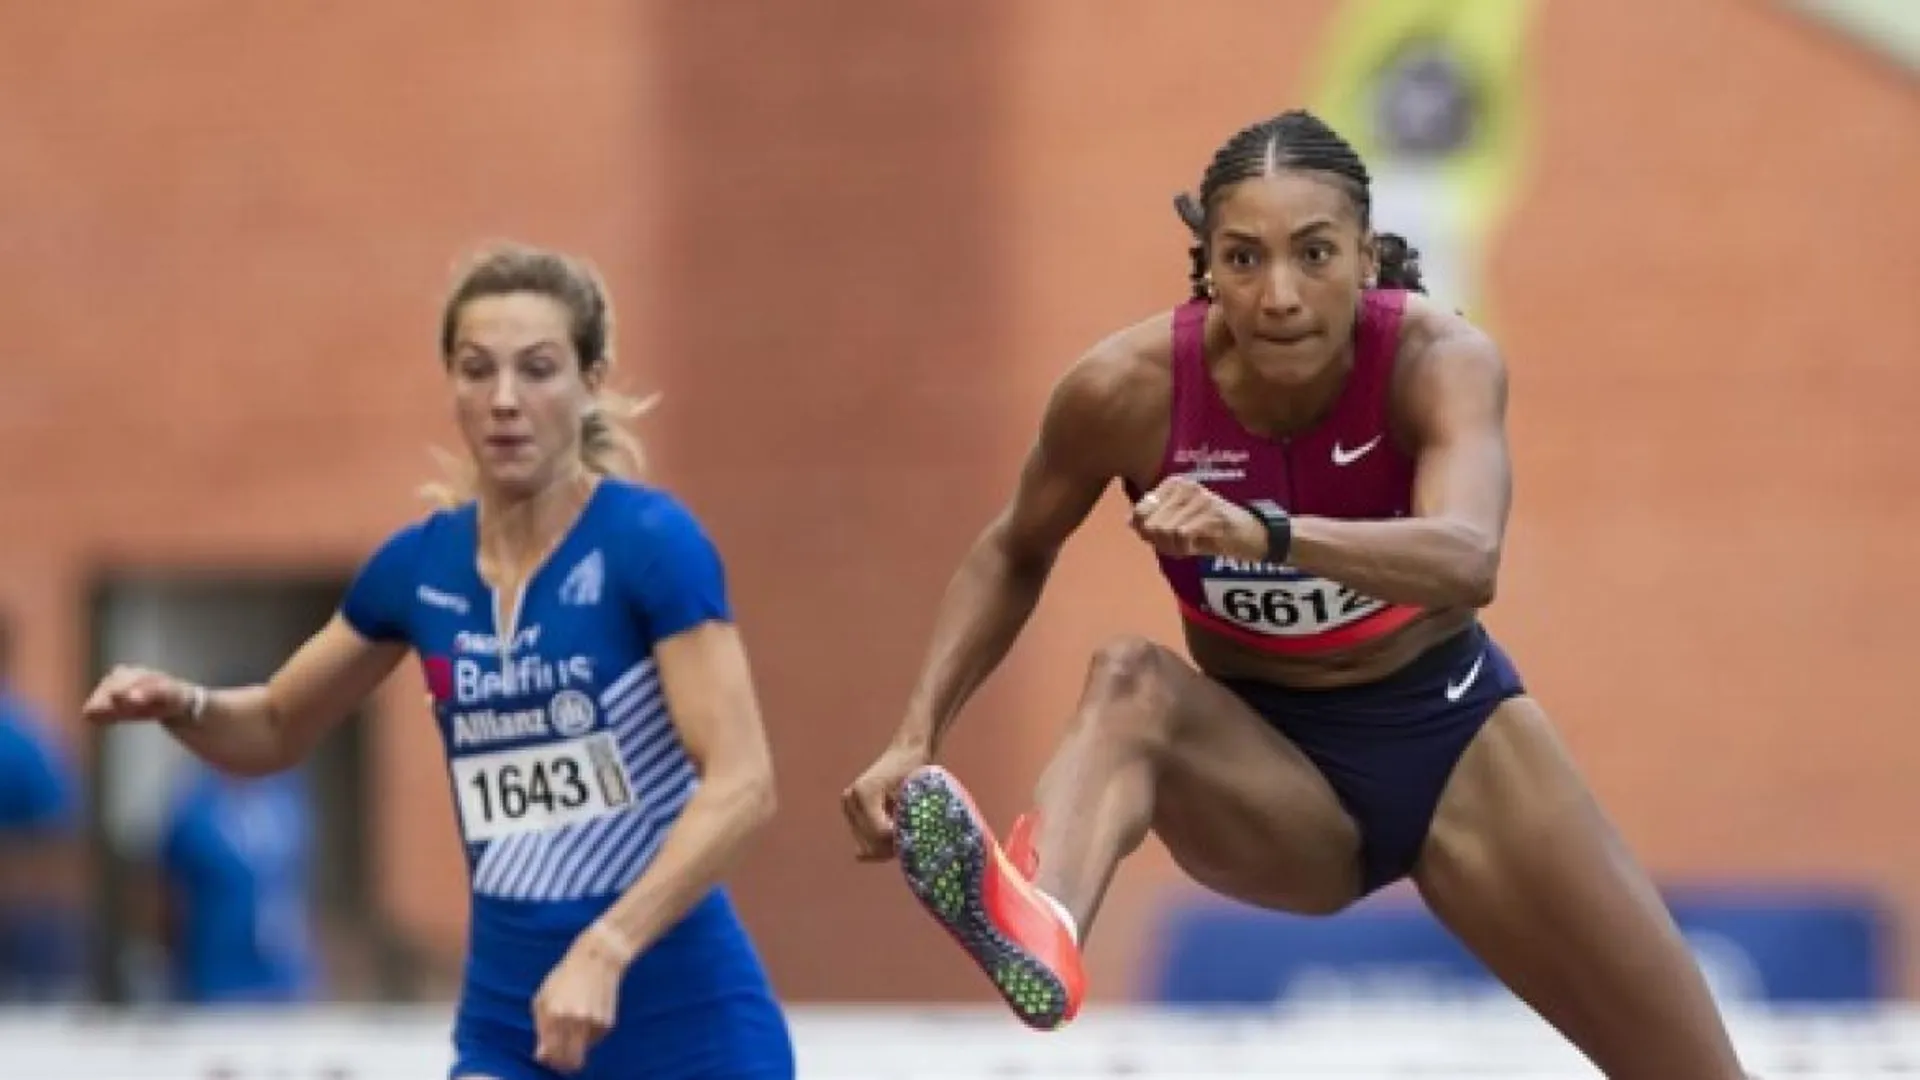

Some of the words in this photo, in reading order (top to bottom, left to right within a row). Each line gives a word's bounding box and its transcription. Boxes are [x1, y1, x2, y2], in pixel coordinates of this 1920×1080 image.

[1223, 583, 1374, 627] 6612
[454, 709, 549, 748] Allianz
[471, 757, 588, 822] 1643
